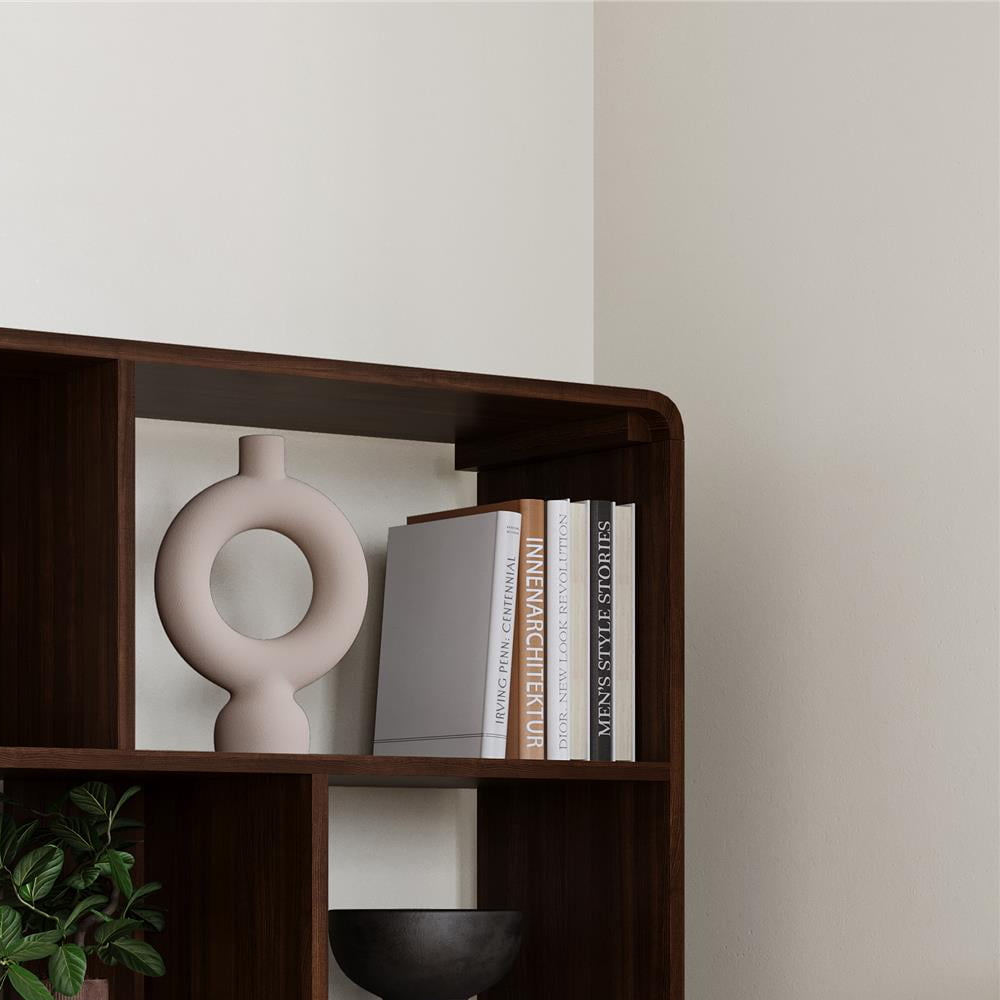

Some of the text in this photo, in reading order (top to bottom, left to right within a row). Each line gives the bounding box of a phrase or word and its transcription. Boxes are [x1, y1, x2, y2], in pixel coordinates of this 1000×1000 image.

[559, 513, 568, 614] REVOLUTION
[597, 520, 611, 736] MEN'S STYLE STORIES
[495, 556, 516, 724] IRVING PENN: CENTENNIAL
[525, 537, 544, 748] INNENARCHITEKTUR
[559, 622, 568, 662] LOOK
[559, 666, 568, 703] NEW
